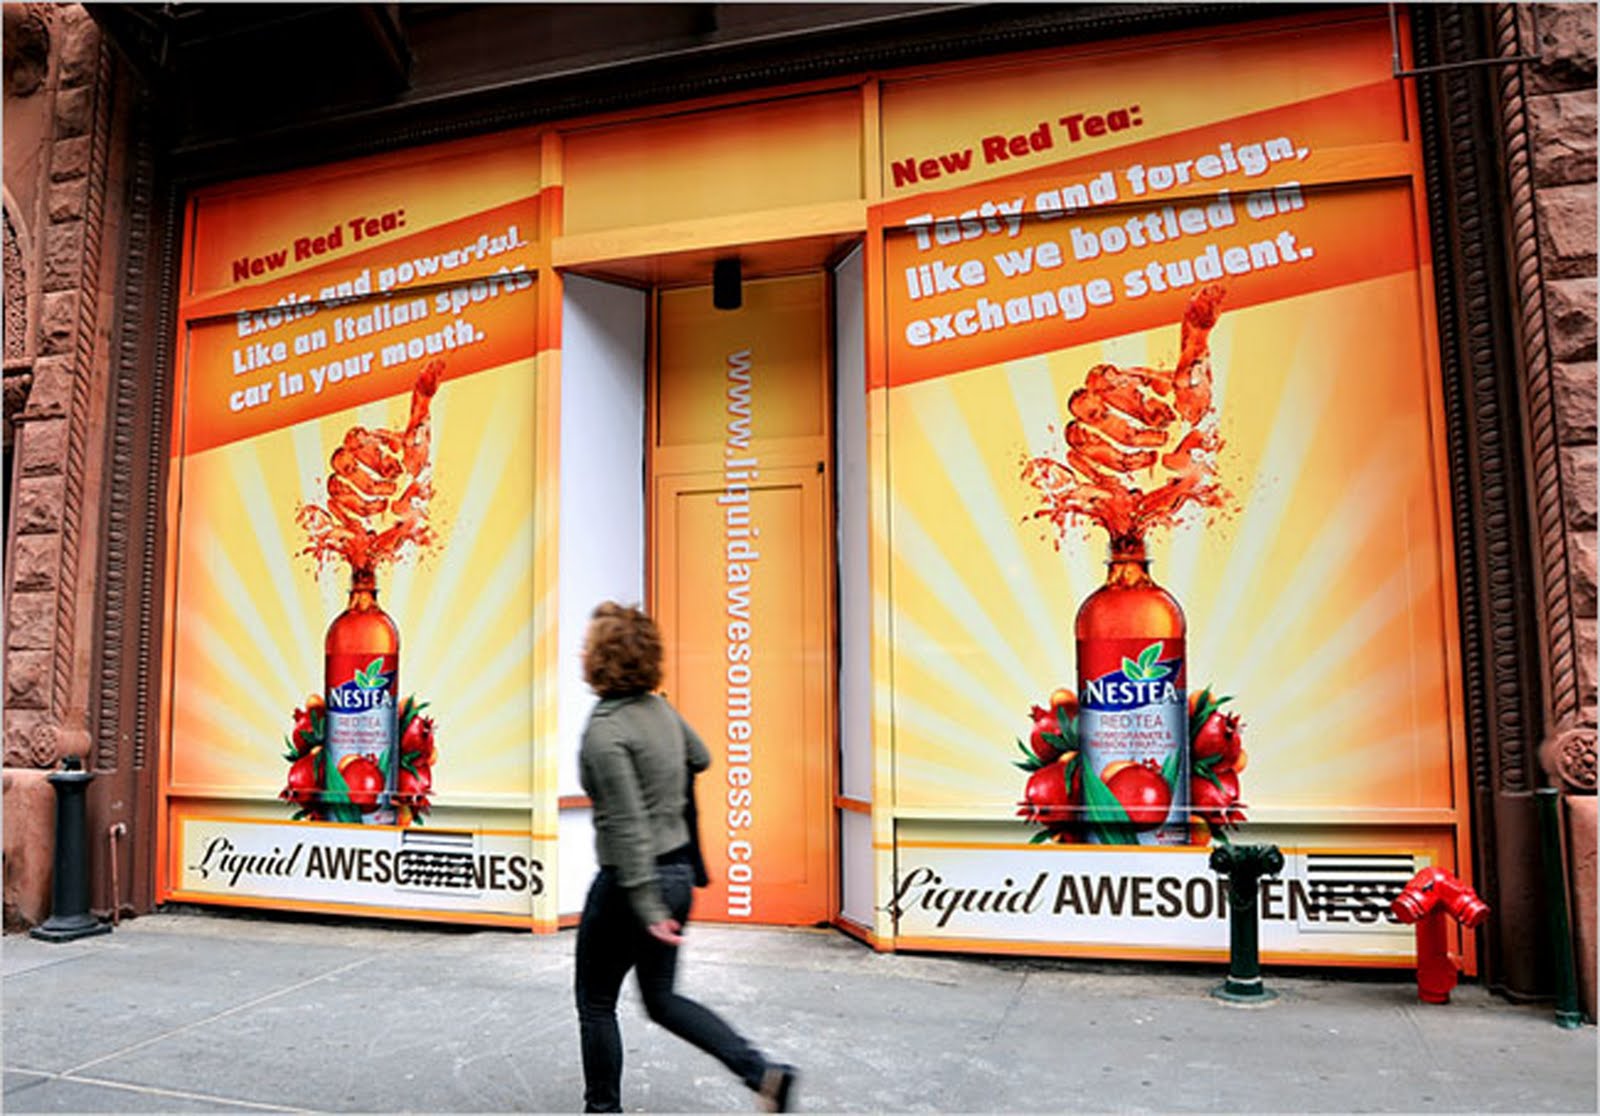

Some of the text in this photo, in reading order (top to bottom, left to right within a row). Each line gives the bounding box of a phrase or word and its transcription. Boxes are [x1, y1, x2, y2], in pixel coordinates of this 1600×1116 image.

[890, 104, 1144, 188] New Red Tea:
[905, 136, 1309, 251] Tasty and foreign,
[231, 208, 407, 283] New Red Tea:
[905, 181, 1306, 301] like we bottled an
[231, 264, 534, 376] Like an Italian sports
[236, 292, 320, 339] Exotic
[319, 269, 371, 306] and
[905, 229, 1315, 347] exchange student.
[229, 317, 485, 413] car in your mouth.
[718, 348, 760, 917] www.liquidawesomeness.com
[330, 688, 394, 708] NESTEA
[1086, 680, 1178, 704] NESTEA
[188, 835, 303, 887] Liquid
[875, 867, 1049, 928] Liquid
